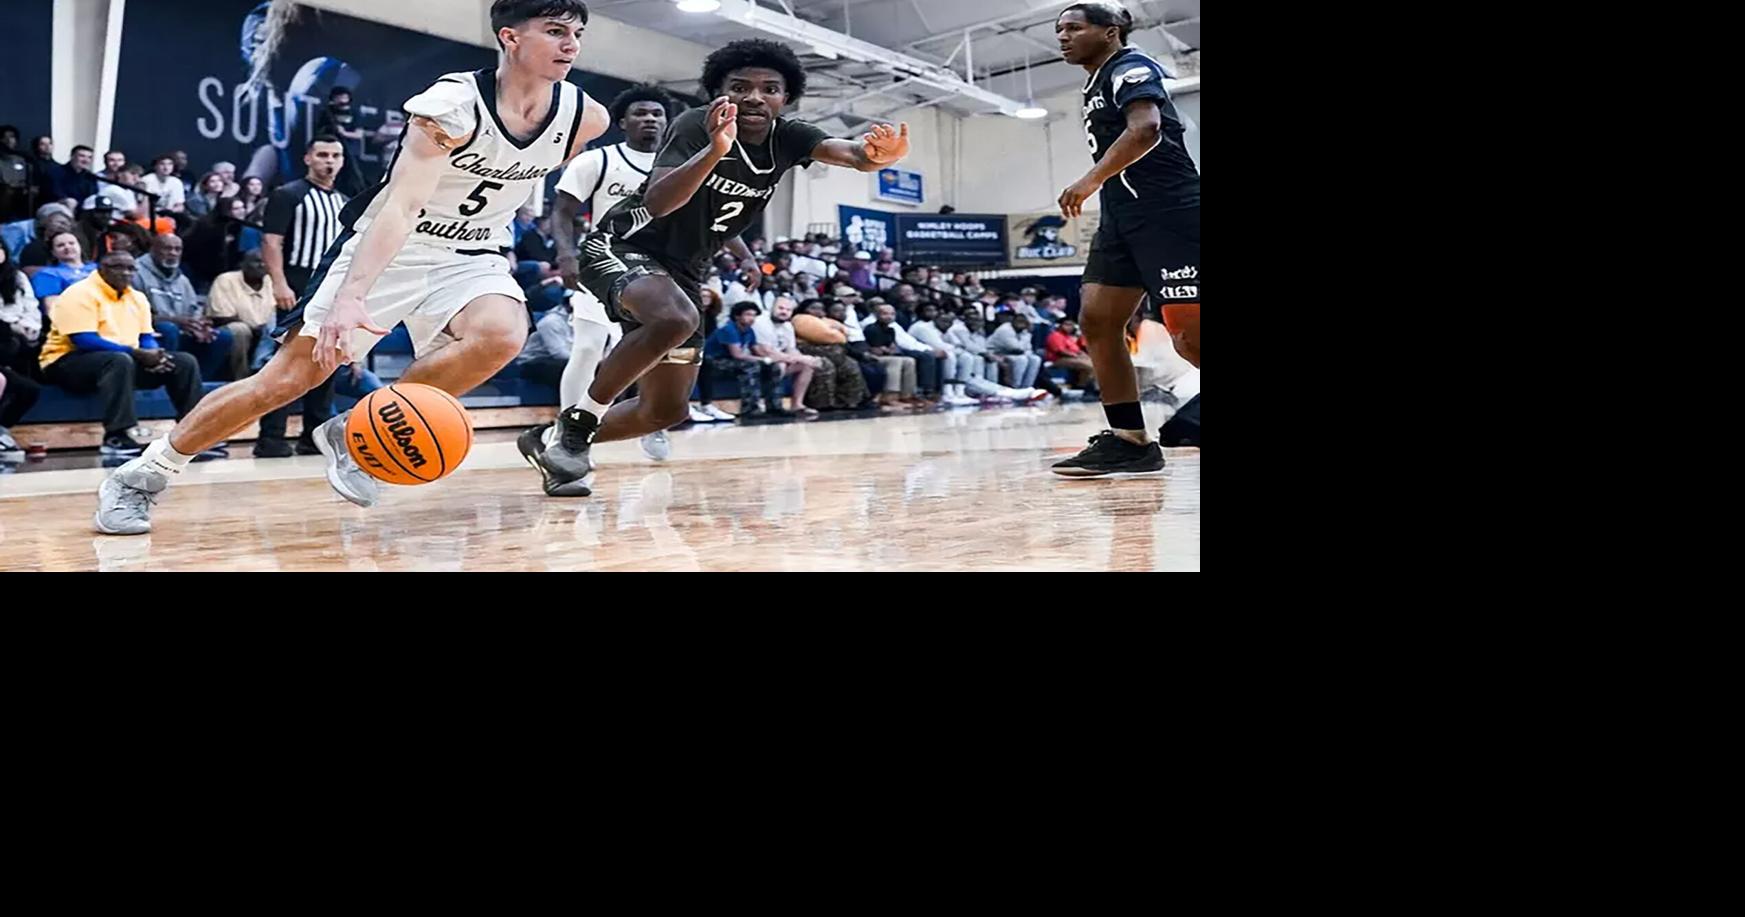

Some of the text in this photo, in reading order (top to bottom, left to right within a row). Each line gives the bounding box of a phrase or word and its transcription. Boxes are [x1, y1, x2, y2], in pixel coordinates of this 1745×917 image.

[458, 180, 504, 217] 5
[416, 208, 491, 241] outhern
[709, 201, 744, 233] 2
[906, 230, 999, 240] BASKETBALL CAMPS
[378, 401, 427, 469] Wilson
